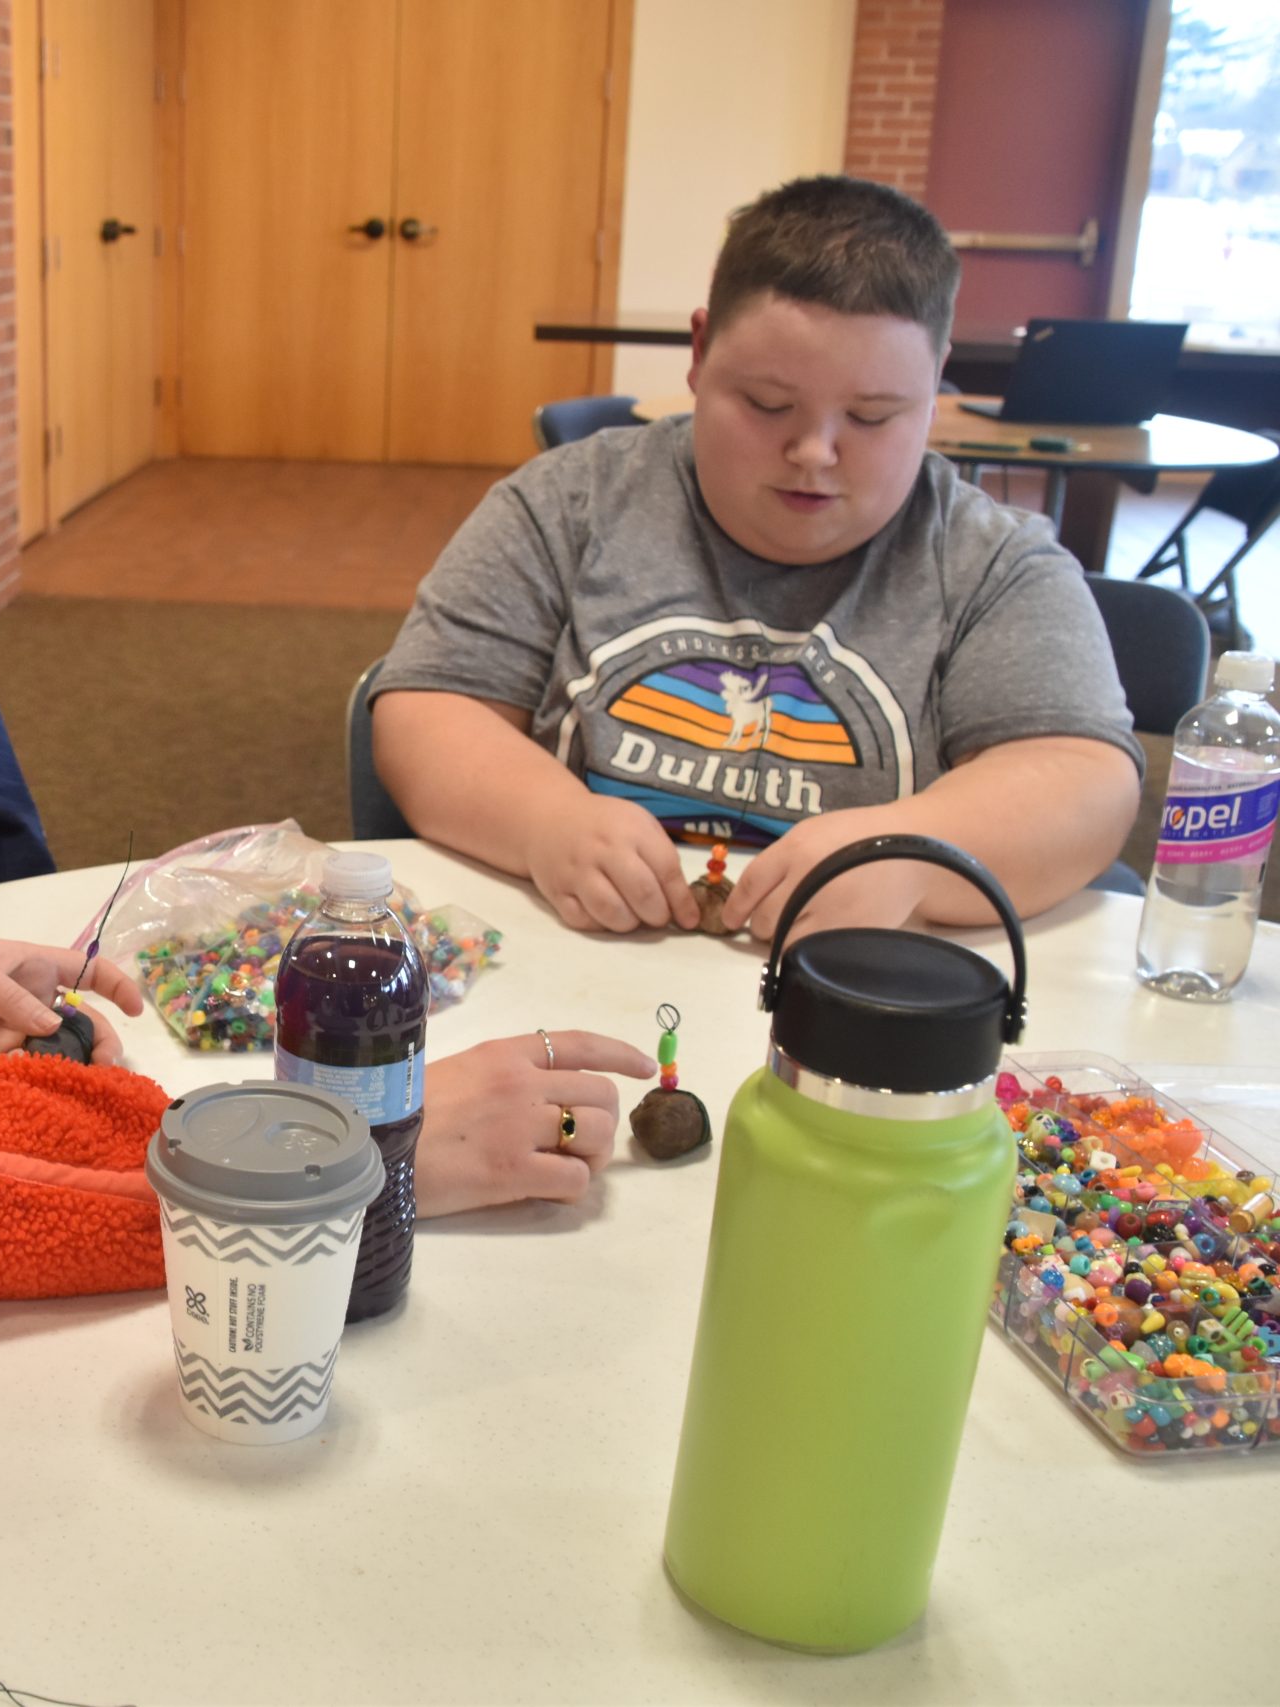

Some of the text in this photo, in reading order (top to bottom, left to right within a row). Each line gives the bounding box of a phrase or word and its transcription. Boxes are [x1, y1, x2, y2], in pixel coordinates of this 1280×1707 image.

[661, 639, 760, 660] ENDLESS
[610, 730, 822, 814] Duluth
[1161, 796, 1242, 837] ropel
[245, 1283, 257, 1338] CONTAINS NO
[255, 1284, 266, 1353] POLYSTYRENE FOAM
